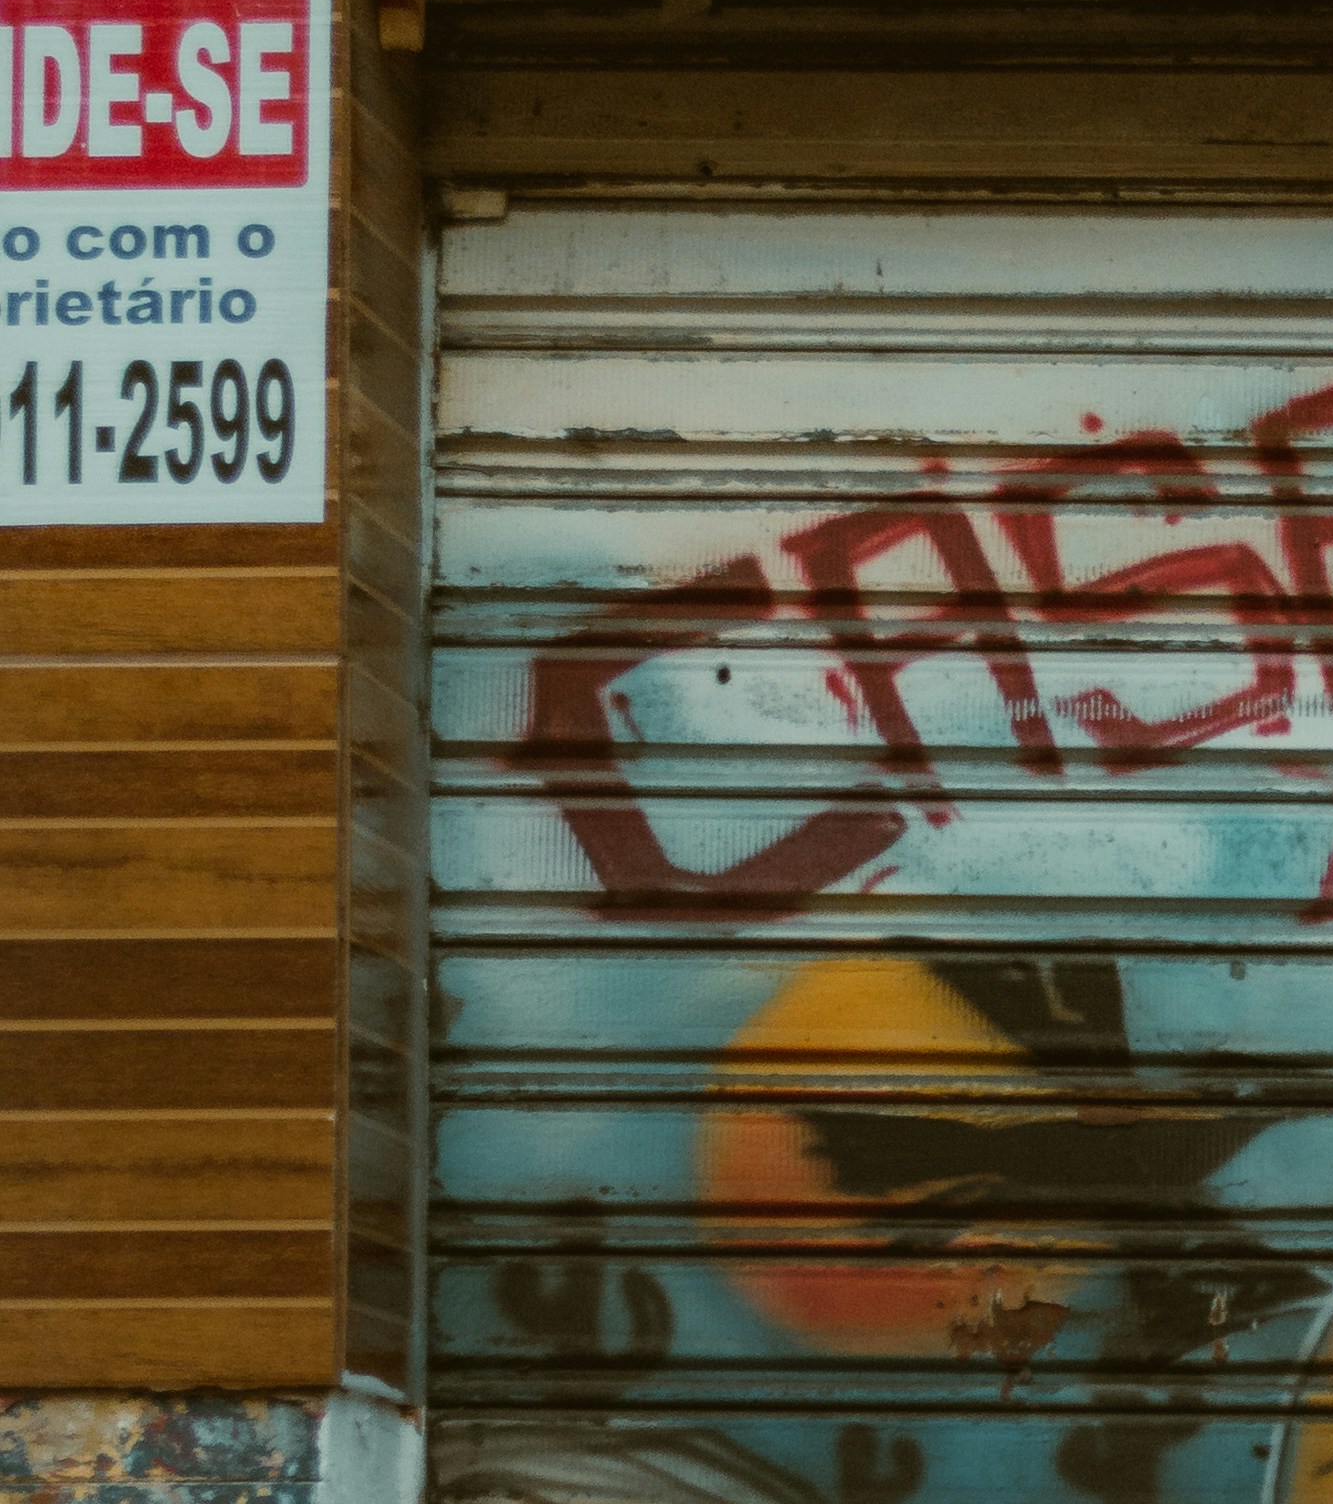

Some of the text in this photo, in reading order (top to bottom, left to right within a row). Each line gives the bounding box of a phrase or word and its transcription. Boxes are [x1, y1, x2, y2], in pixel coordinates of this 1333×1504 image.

[0, 21, 294, 159] DE-SE
[66, 223, 211, 261] com
[237, 222, 276, 260] o
[7, 277, 258, 326] rietário
[9, 358, 296, 486] 11-2599
